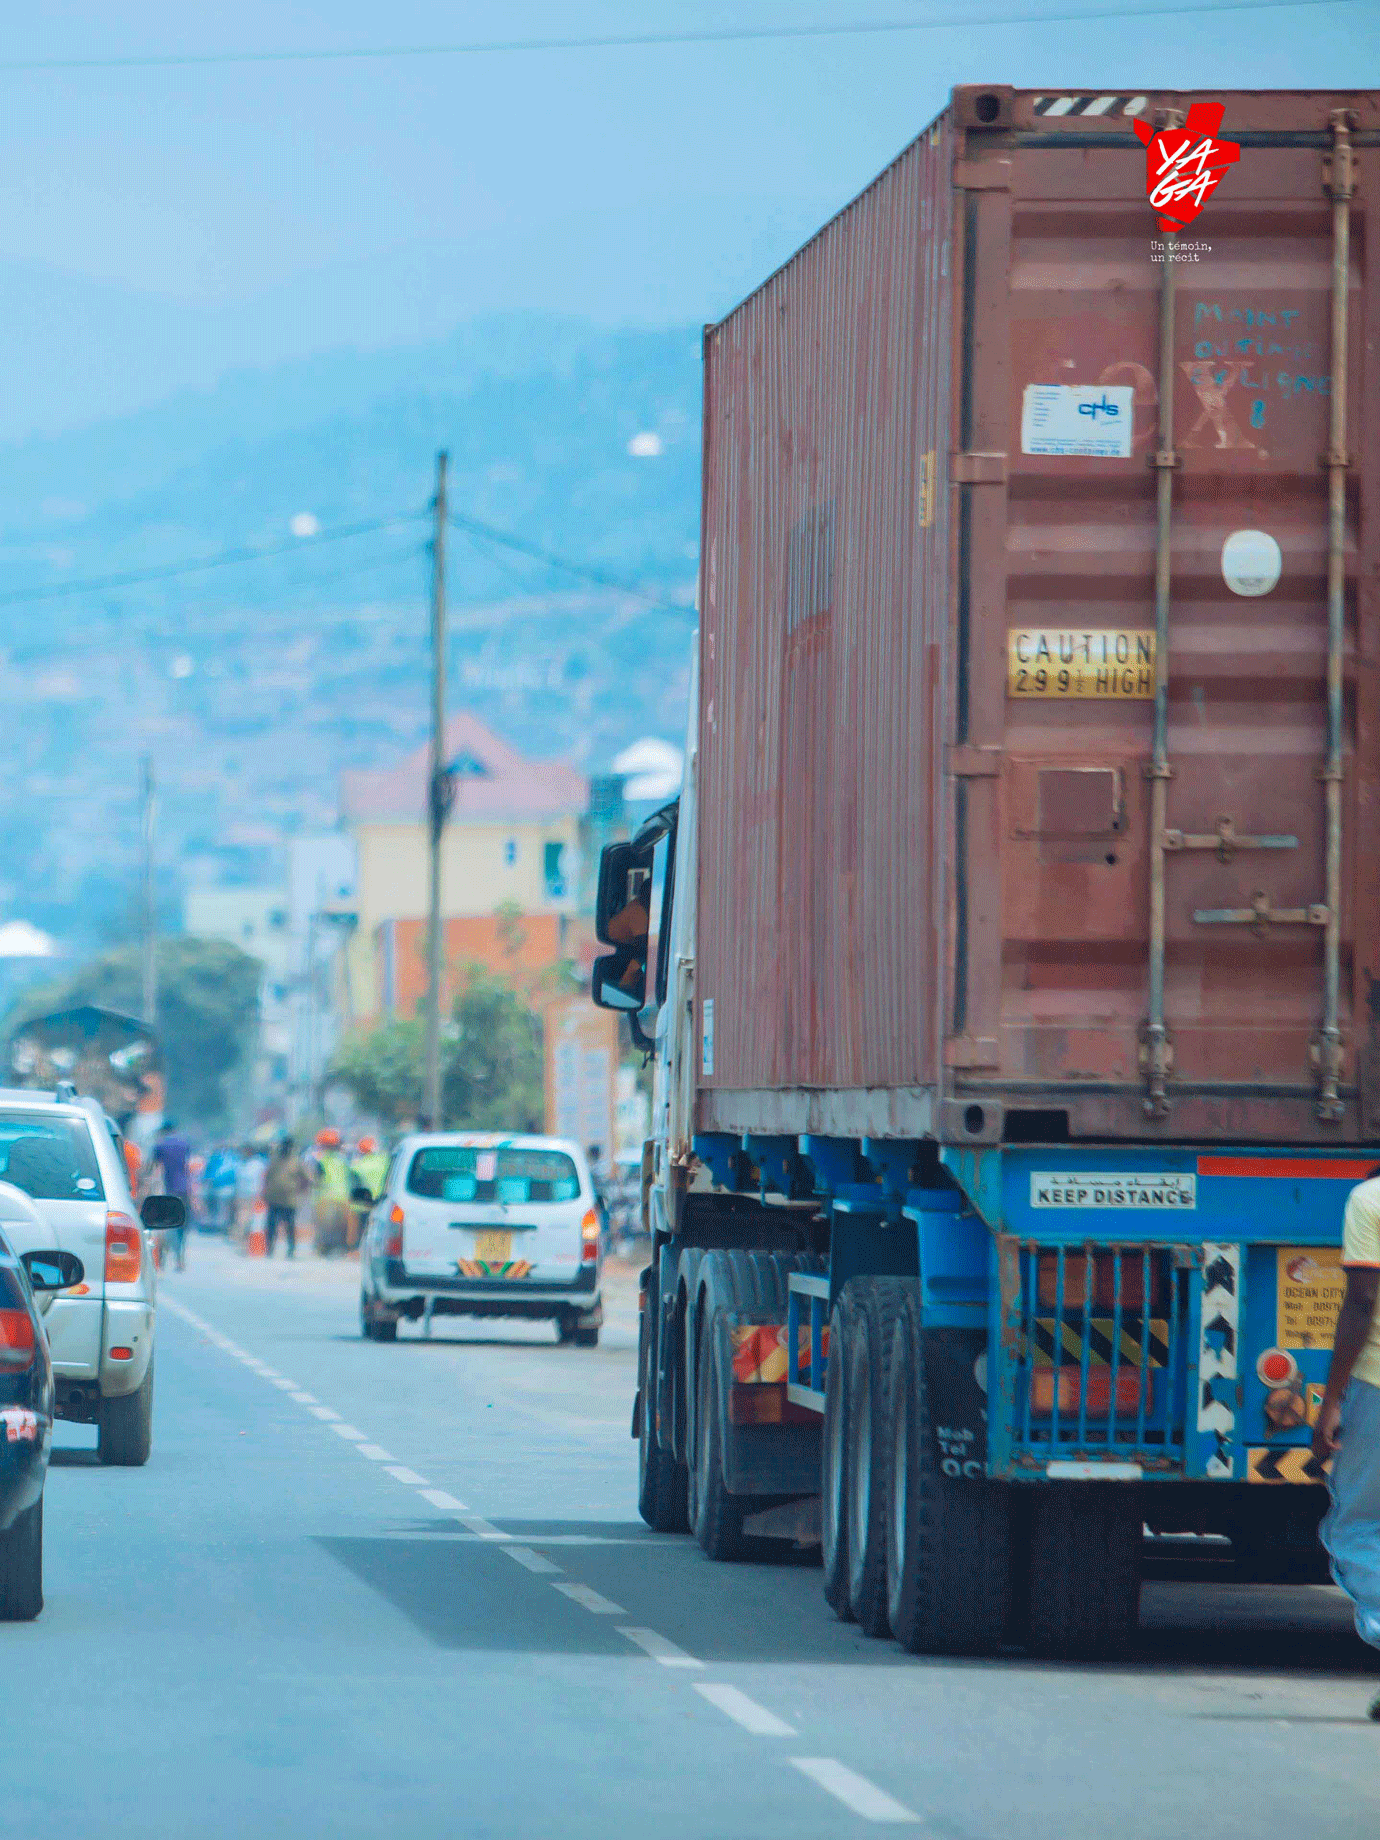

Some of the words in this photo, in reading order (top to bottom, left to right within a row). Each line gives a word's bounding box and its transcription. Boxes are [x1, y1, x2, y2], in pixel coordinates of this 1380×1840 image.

[1016, 634, 1152, 664] CAUTION
[1095, 667, 1152, 694] HIGH
[1038, 1189, 1088, 1203] KEEP
[1093, 1190, 1191, 1205] DISTANCE
[941, 1458, 988, 1478] OC
